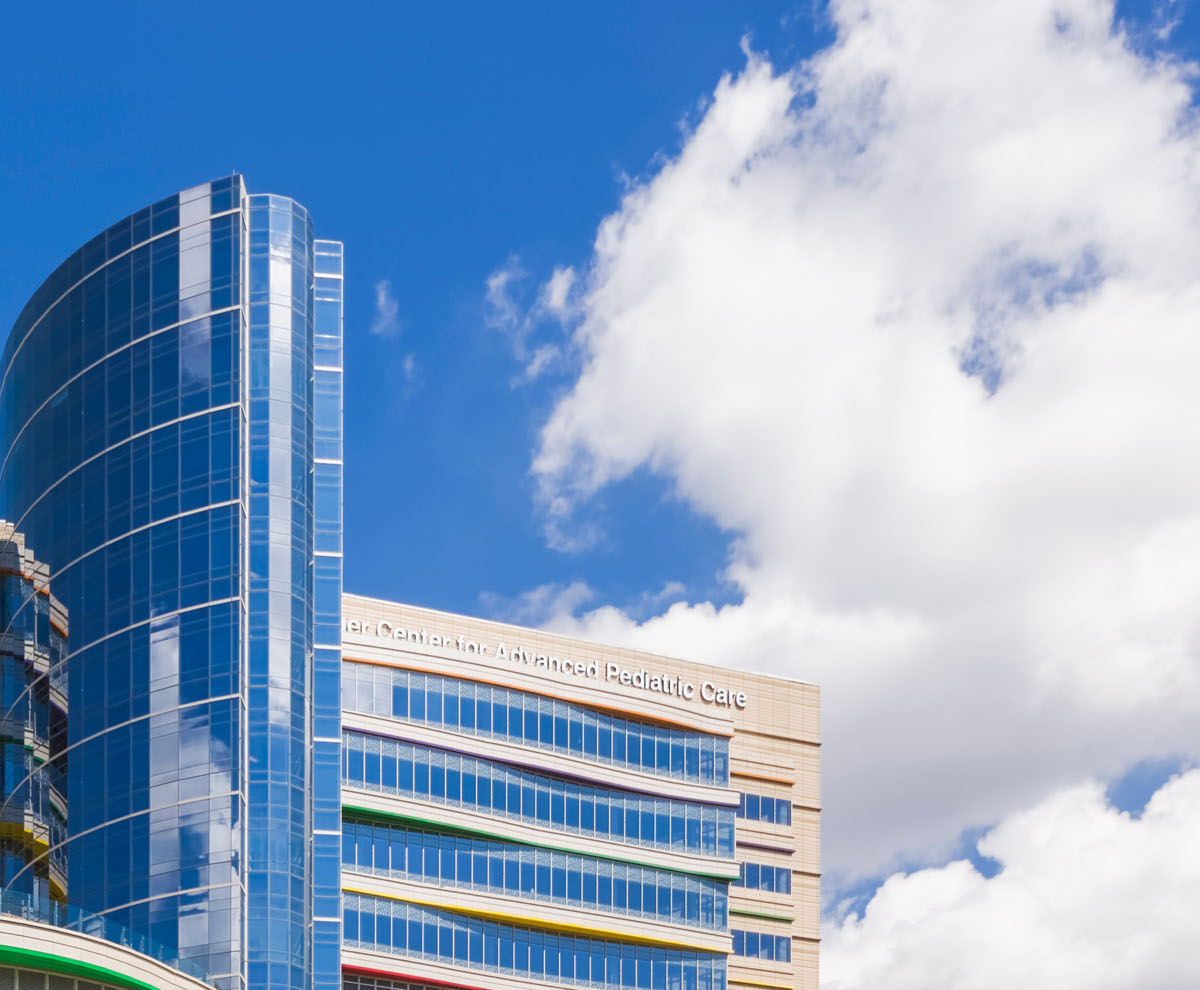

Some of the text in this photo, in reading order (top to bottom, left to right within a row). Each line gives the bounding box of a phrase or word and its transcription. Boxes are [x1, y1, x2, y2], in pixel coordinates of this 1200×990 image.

[343, 619, 747, 709] er Center for Advanced Pediatric Care
